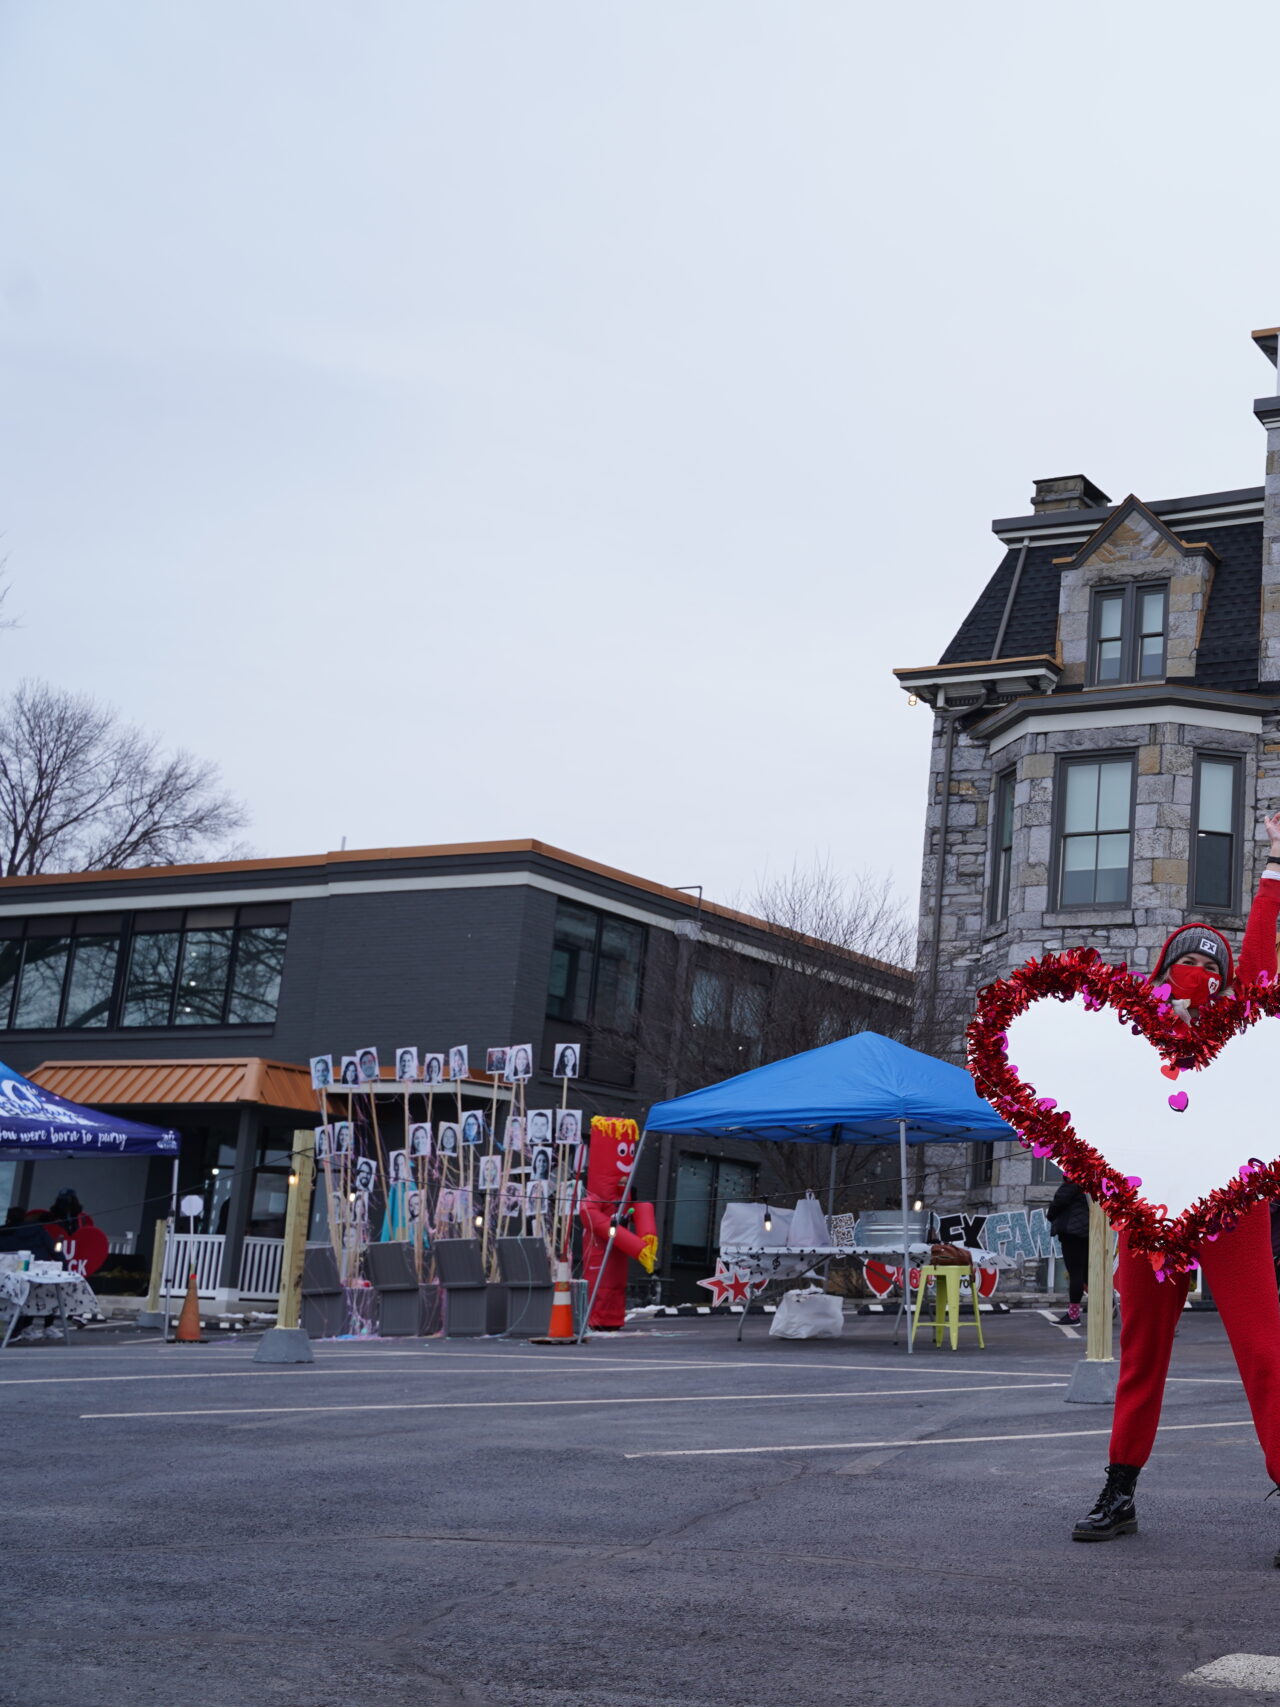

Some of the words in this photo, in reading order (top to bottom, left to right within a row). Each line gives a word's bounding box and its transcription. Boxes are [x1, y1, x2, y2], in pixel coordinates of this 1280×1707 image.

[1201, 940, 1215, 952] FX
[20, 1129, 46, 1142] were
[50, 1126, 79, 1144] born
[68, 1259, 88, 1276] CK
